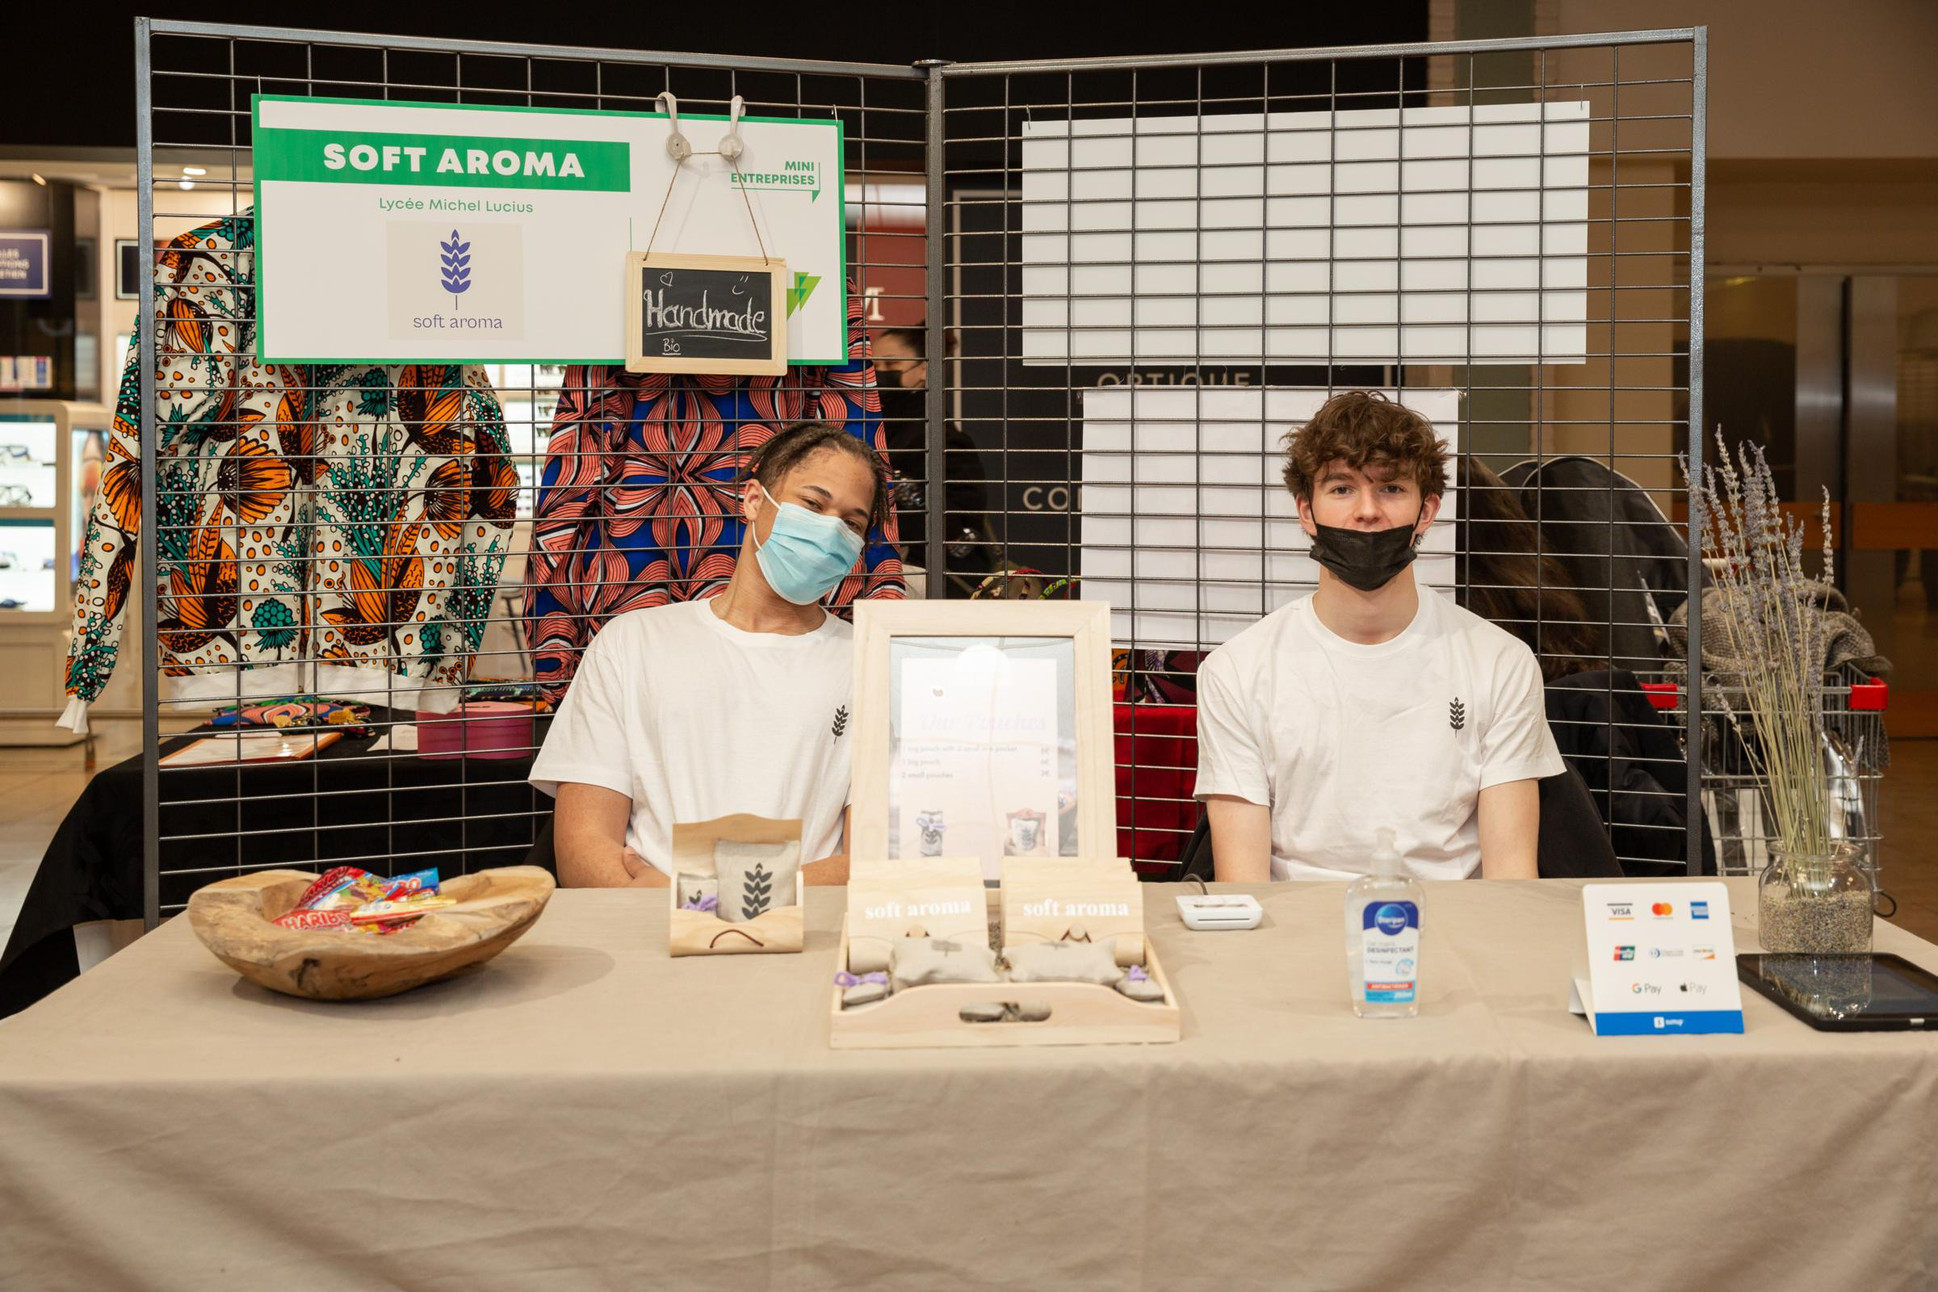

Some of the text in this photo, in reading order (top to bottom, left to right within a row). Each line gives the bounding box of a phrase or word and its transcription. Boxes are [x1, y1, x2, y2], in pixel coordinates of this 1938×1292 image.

[323, 143, 586, 178] SOFT AROMA
[784, 160, 815, 172] MINI
[730, 172, 815, 186] ENTREPRISES
[379, 197, 534, 213] Lycée Michel Lucius
[643, 288, 768, 334] Handmade
[413, 314, 503, 329] soft aroma
[662, 337, 681, 353] Bio
[1022, 486, 1082, 511] CO
[864, 899, 972, 919] soft aroma
[1023, 898, 1129, 917] soft aroma
[1612, 908, 1631, 916] VISA
